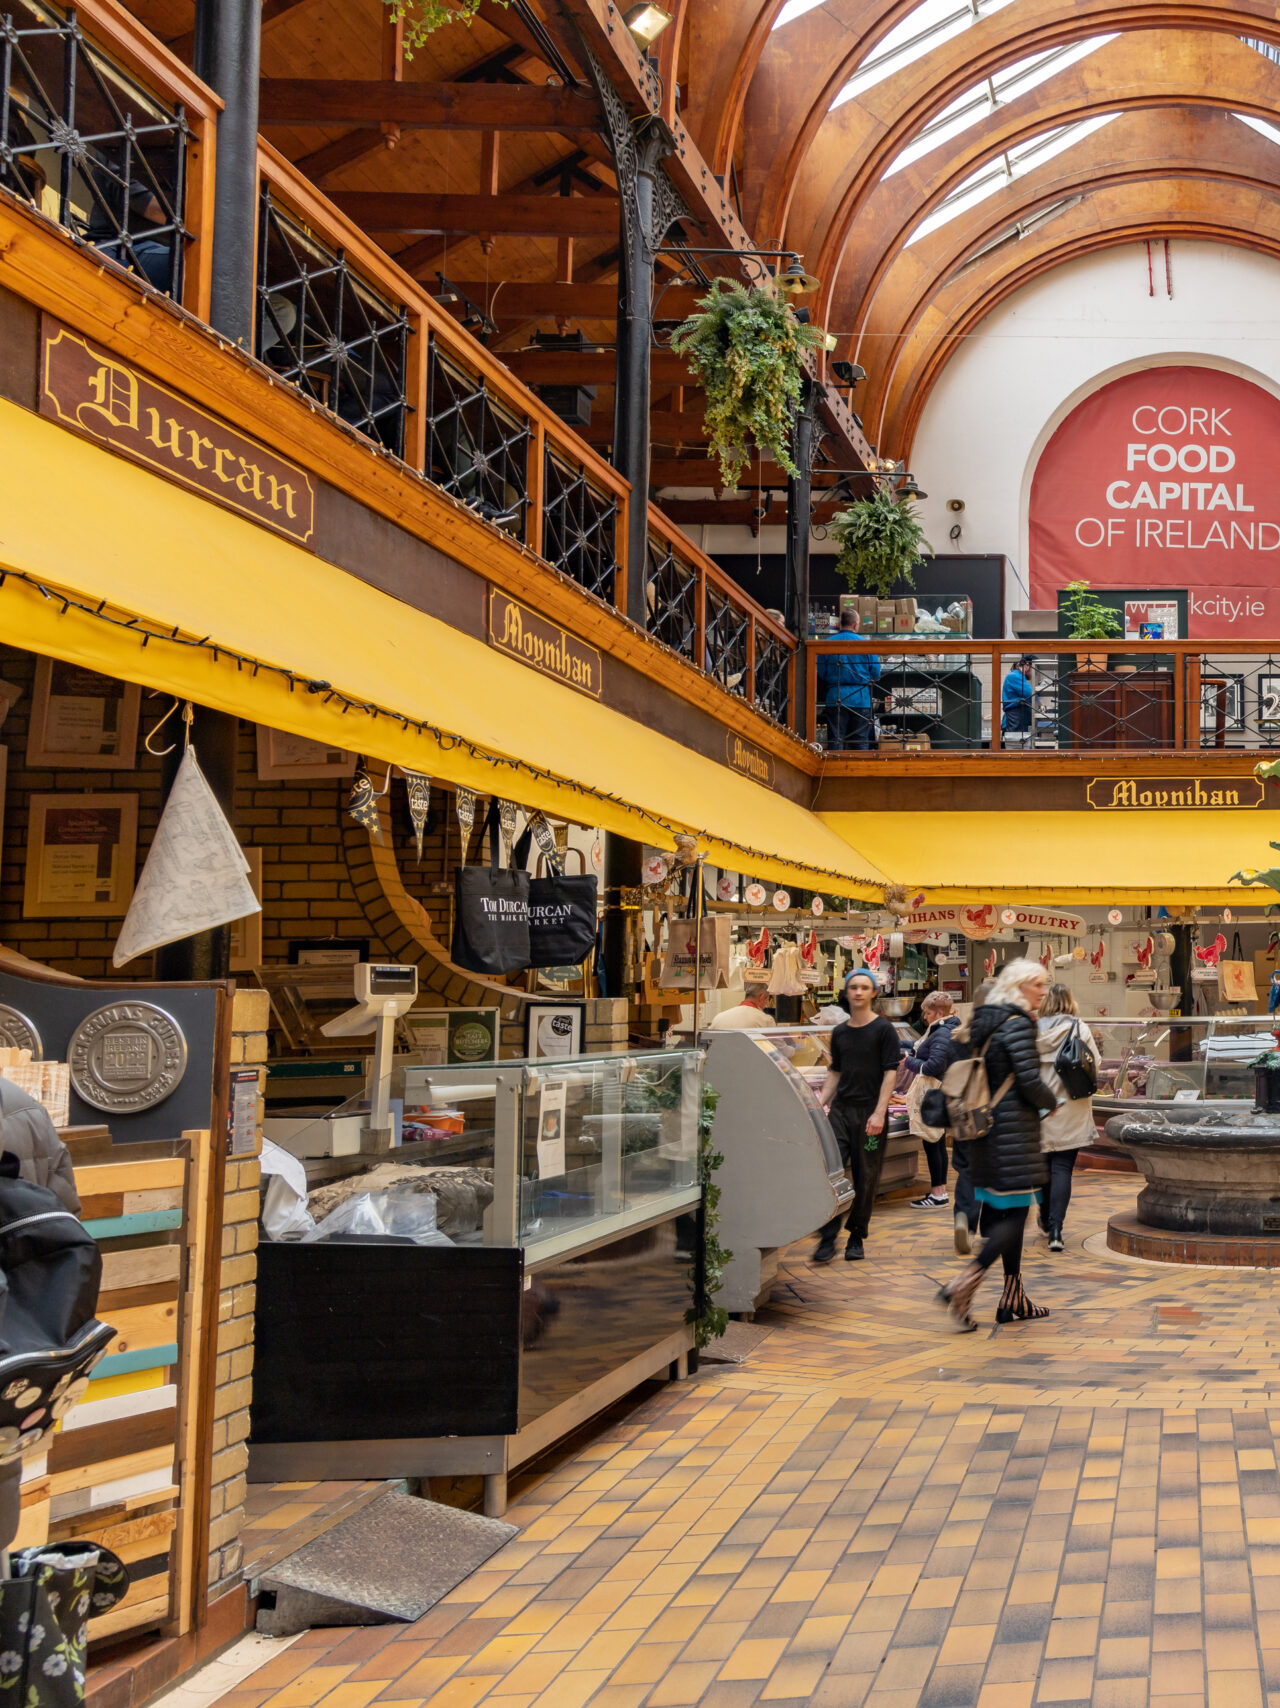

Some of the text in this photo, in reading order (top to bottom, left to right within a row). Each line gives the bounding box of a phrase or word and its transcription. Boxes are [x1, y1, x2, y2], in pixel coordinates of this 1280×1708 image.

[1132, 405, 1232, 436] CORK
[77, 346, 297, 519] Durcan
[1126, 443, 1236, 474] FOOD
[1105, 480, 1255, 512] CAPITAL
[1075, 517, 1126, 548] OF
[1187, 592, 1265, 623] kcity.ie
[501, 602, 593, 689] Moynihan
[410, 797, 429, 811] taste
[1108, 780, 1240, 808] Moynihan
[457, 808, 474, 824] taste
[480, 897, 497, 912] TOM
[527, 904, 573, 918] URCAN
[528, 917, 565, 926] ARKET
[906, 909, 1081, 931] NIHANS OULTRY
[552, 1020, 572, 1032] taste
[104, 1036, 147, 1045] BEST IN
[104, 1044, 147, 1052] IRELAND
[147, 1013, 181, 1066] GUIDES
[104, 1052, 147, 1069] 2022
